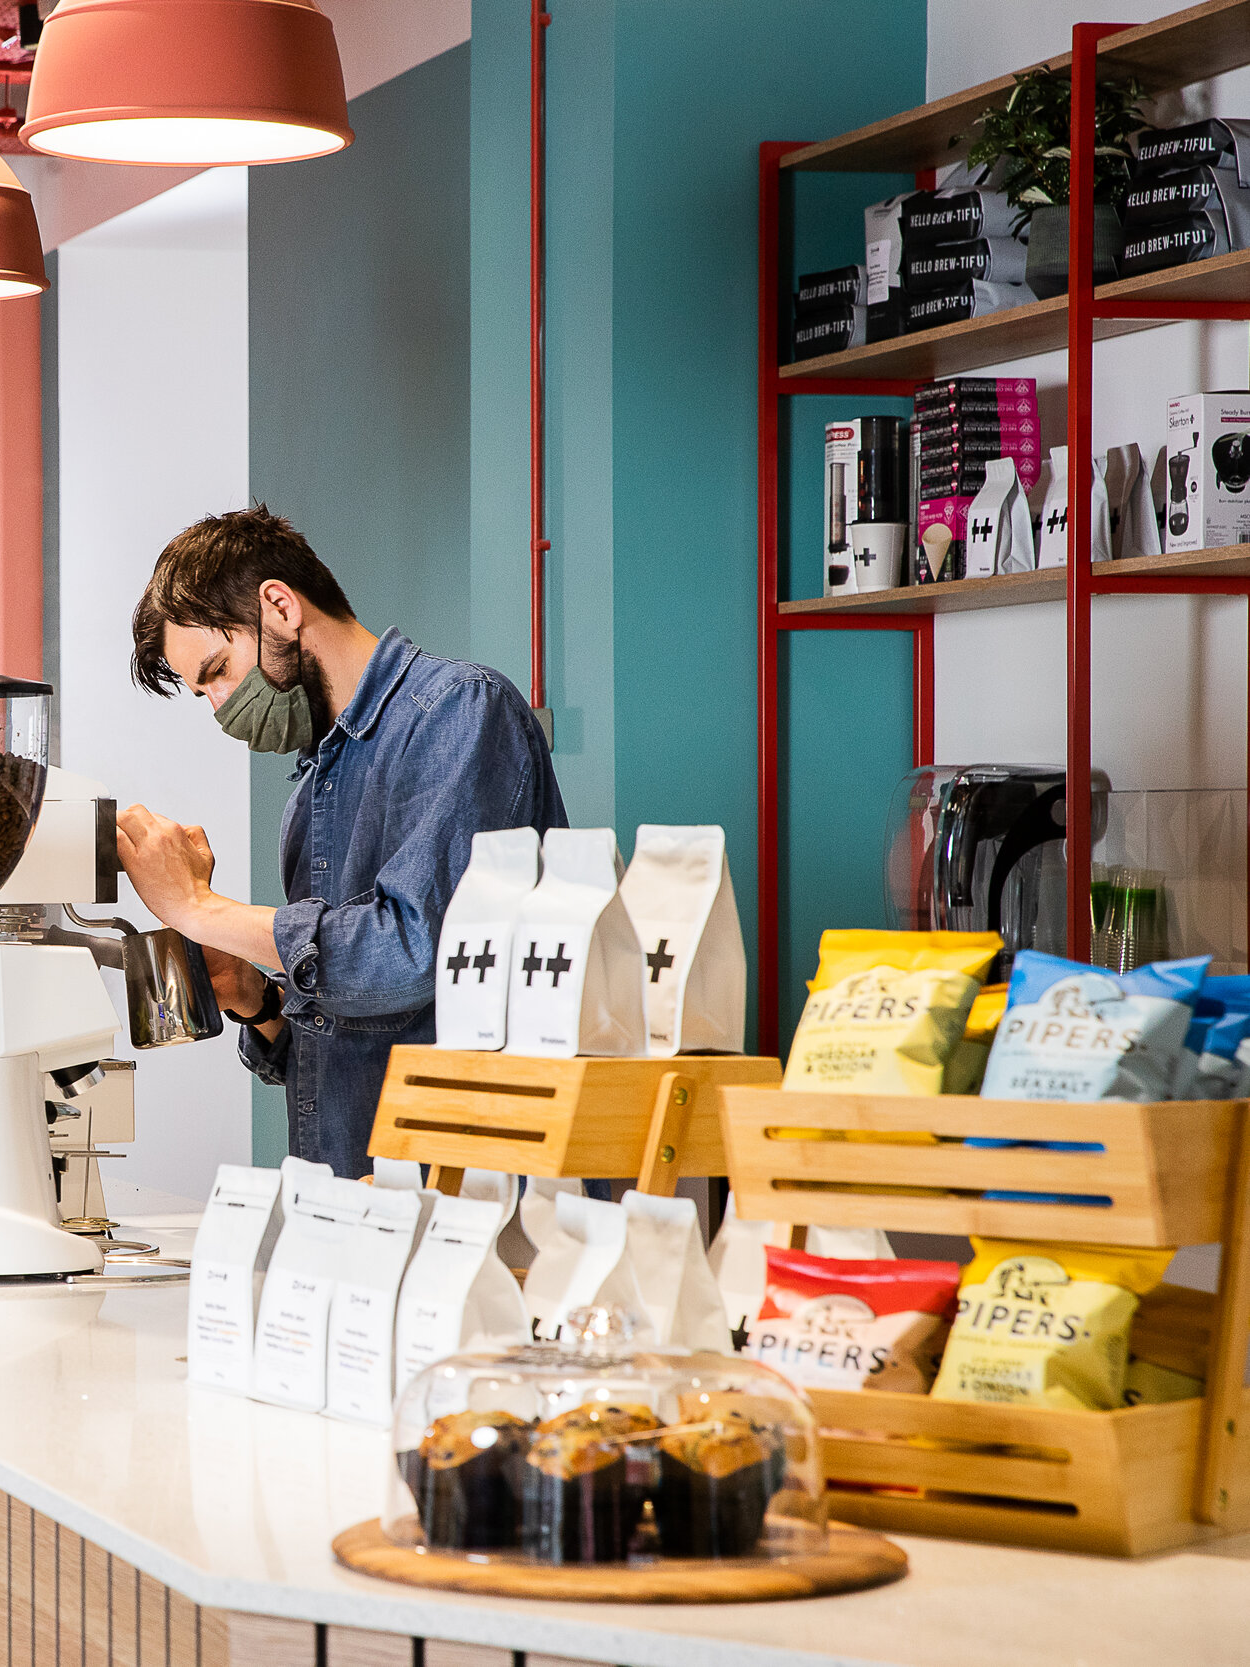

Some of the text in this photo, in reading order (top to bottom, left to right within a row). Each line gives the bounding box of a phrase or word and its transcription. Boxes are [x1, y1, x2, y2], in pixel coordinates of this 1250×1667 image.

[1138, 137, 1216, 161] ELLO BREW-TIFUL
[932, 207, 980, 225] BREW-TIFU
[1125, 241, 1146, 259] HELLO
[911, 260, 933, 275] HELLO
[817, 279, 860, 298] BREW-TIFU
[814, 320, 854, 338] BREW-TIFU
[800, 995, 920, 1024] PIPERS
[1002, 1019, 1141, 1054] PIPERS
[958, 1300, 1082, 1341] PIPERS
[760, 1334, 888, 1374] PIPERS
